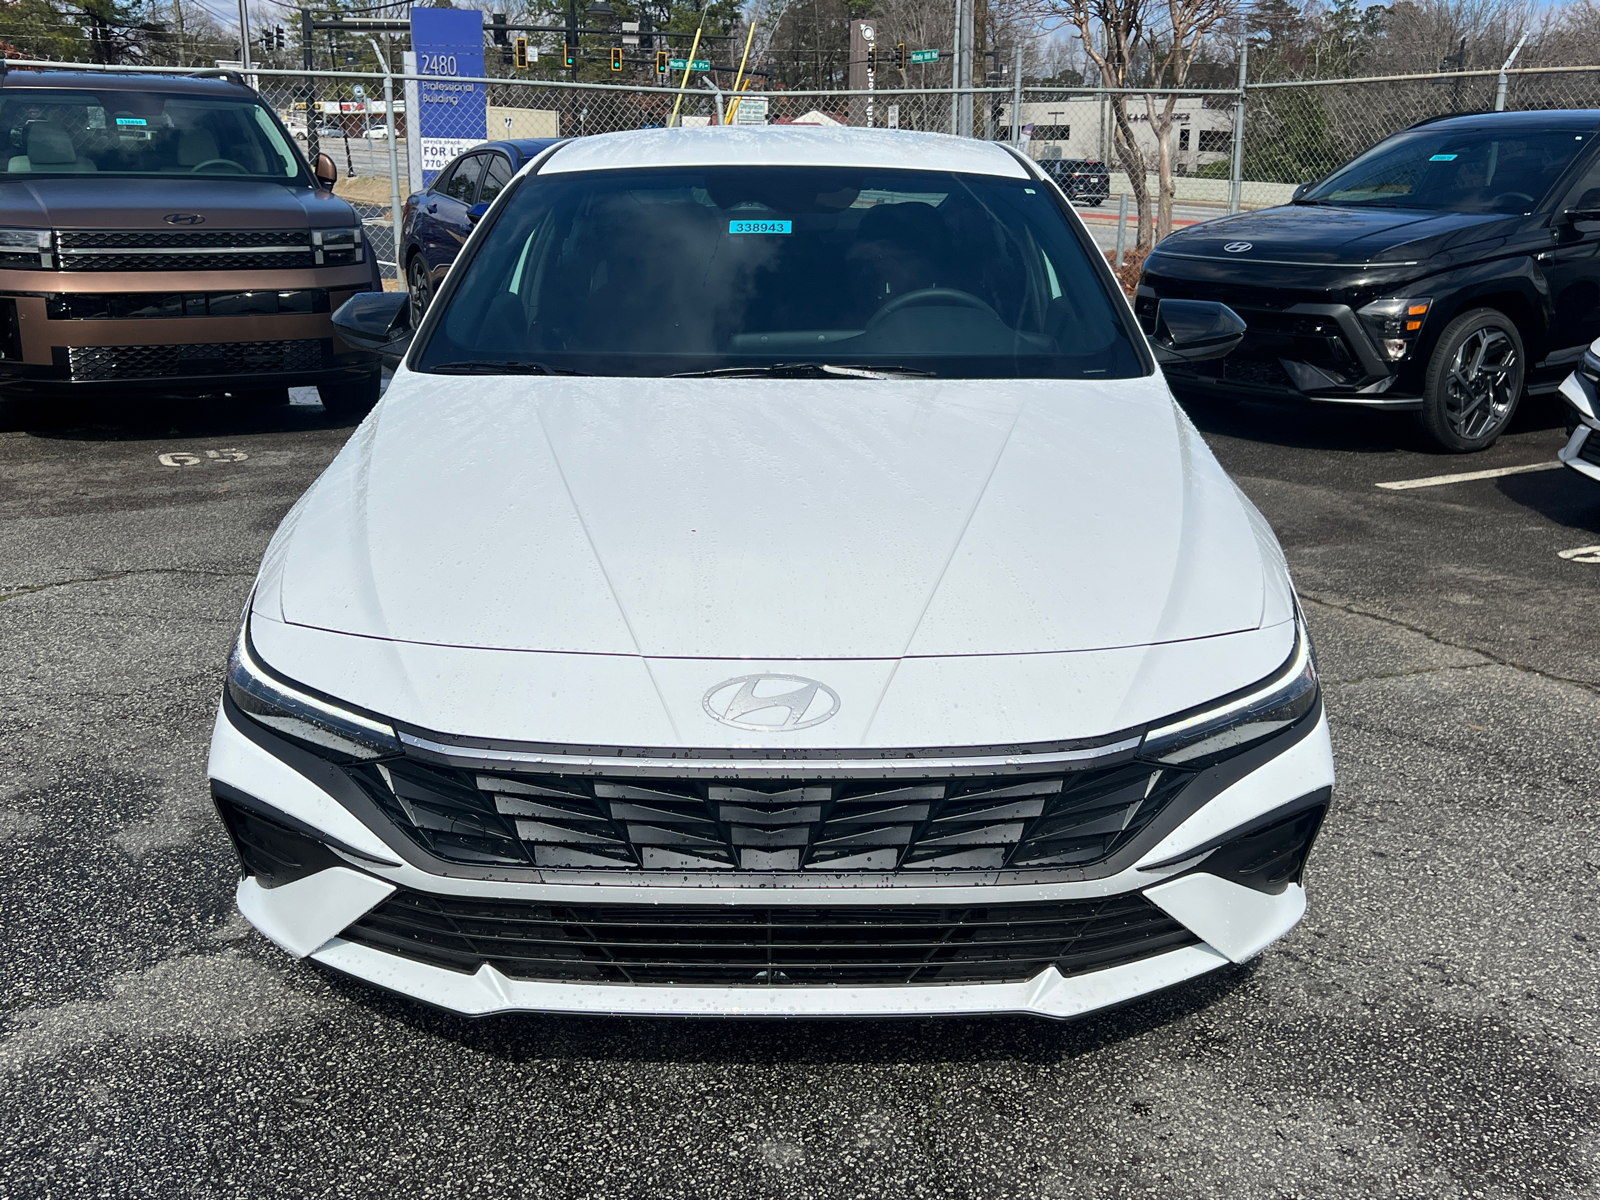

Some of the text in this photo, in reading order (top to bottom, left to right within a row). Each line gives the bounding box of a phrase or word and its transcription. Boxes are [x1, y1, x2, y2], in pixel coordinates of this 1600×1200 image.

[932, 51, 938, 59] Rd
[422, 55, 457, 76] 2480
[670, 60, 684, 68] North
[423, 82, 474, 92] Professional
[423, 93, 458, 106] Building
[424, 146, 446, 156] FOR
[736, 223, 785, 233] 338943
[158, 448, 249, 467] 65
